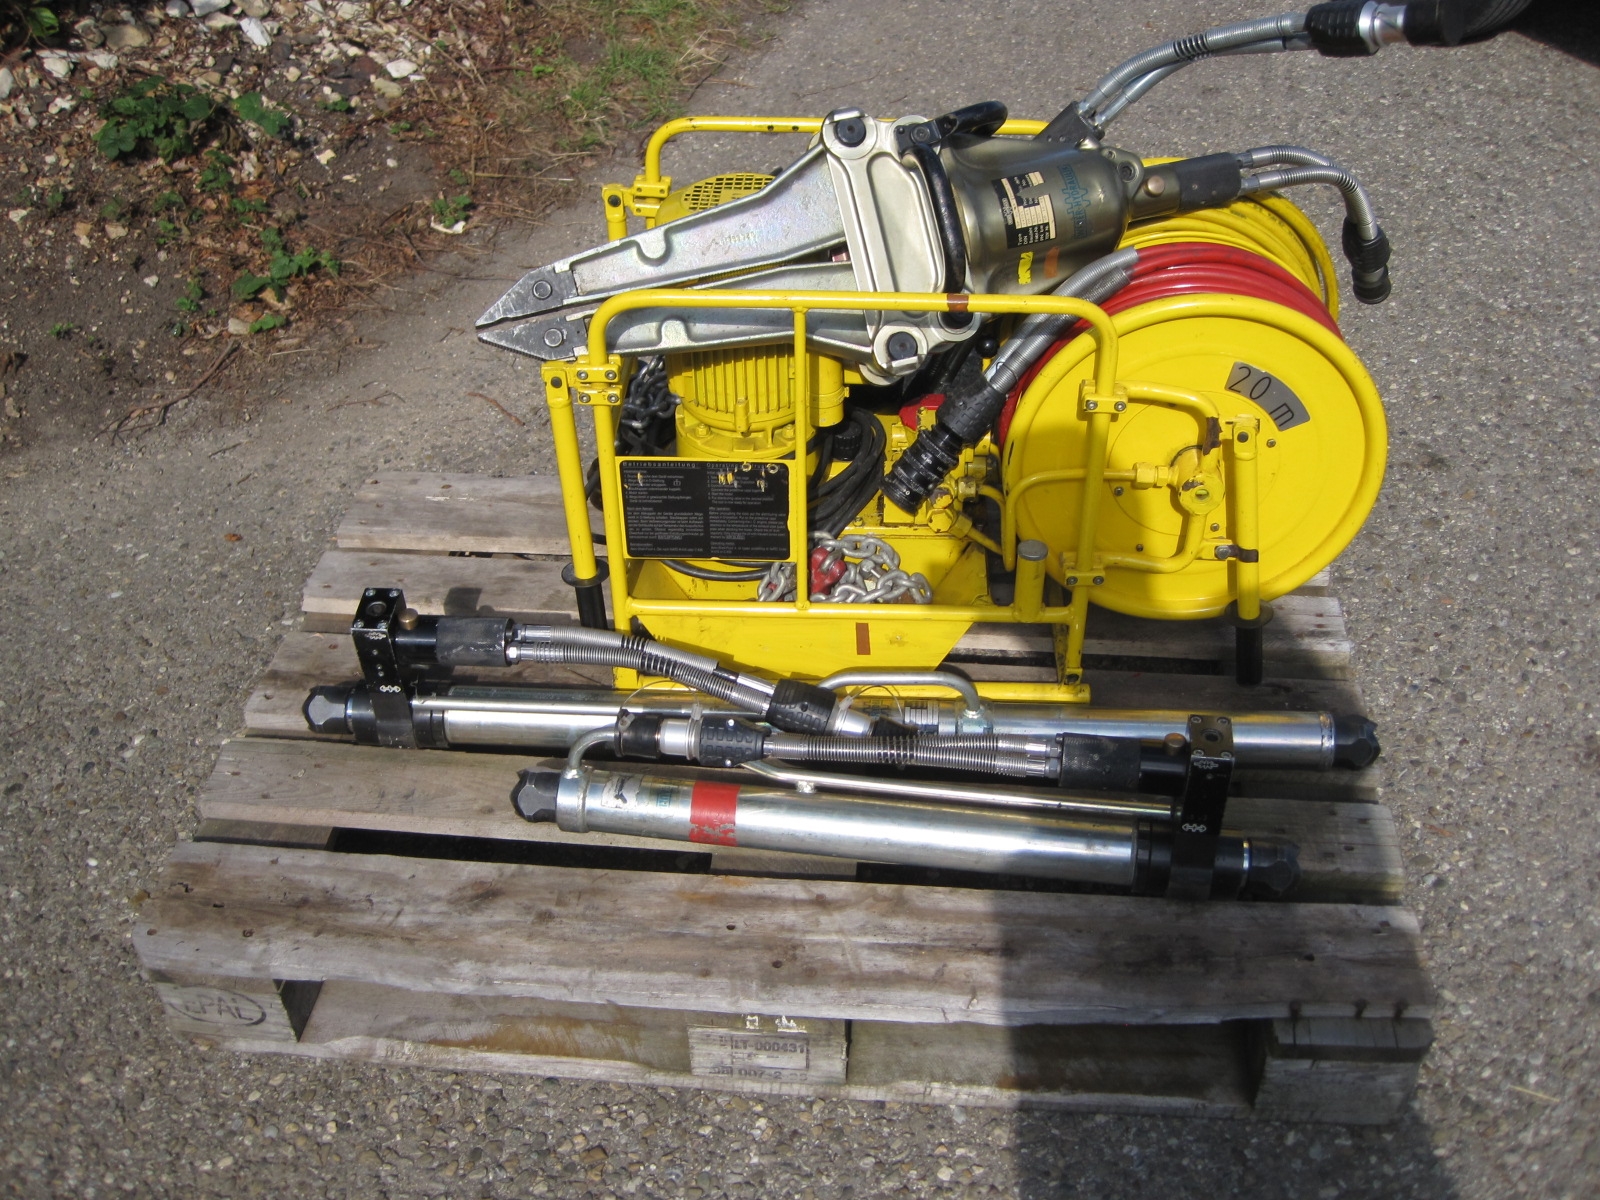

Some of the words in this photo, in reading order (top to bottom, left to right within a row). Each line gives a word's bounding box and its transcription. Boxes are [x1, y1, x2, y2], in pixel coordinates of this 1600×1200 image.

[1228, 365, 1272, 400] 20
[1269, 402, 1294, 427] m
[622, 461, 697, 469] Betriebsanleitung
